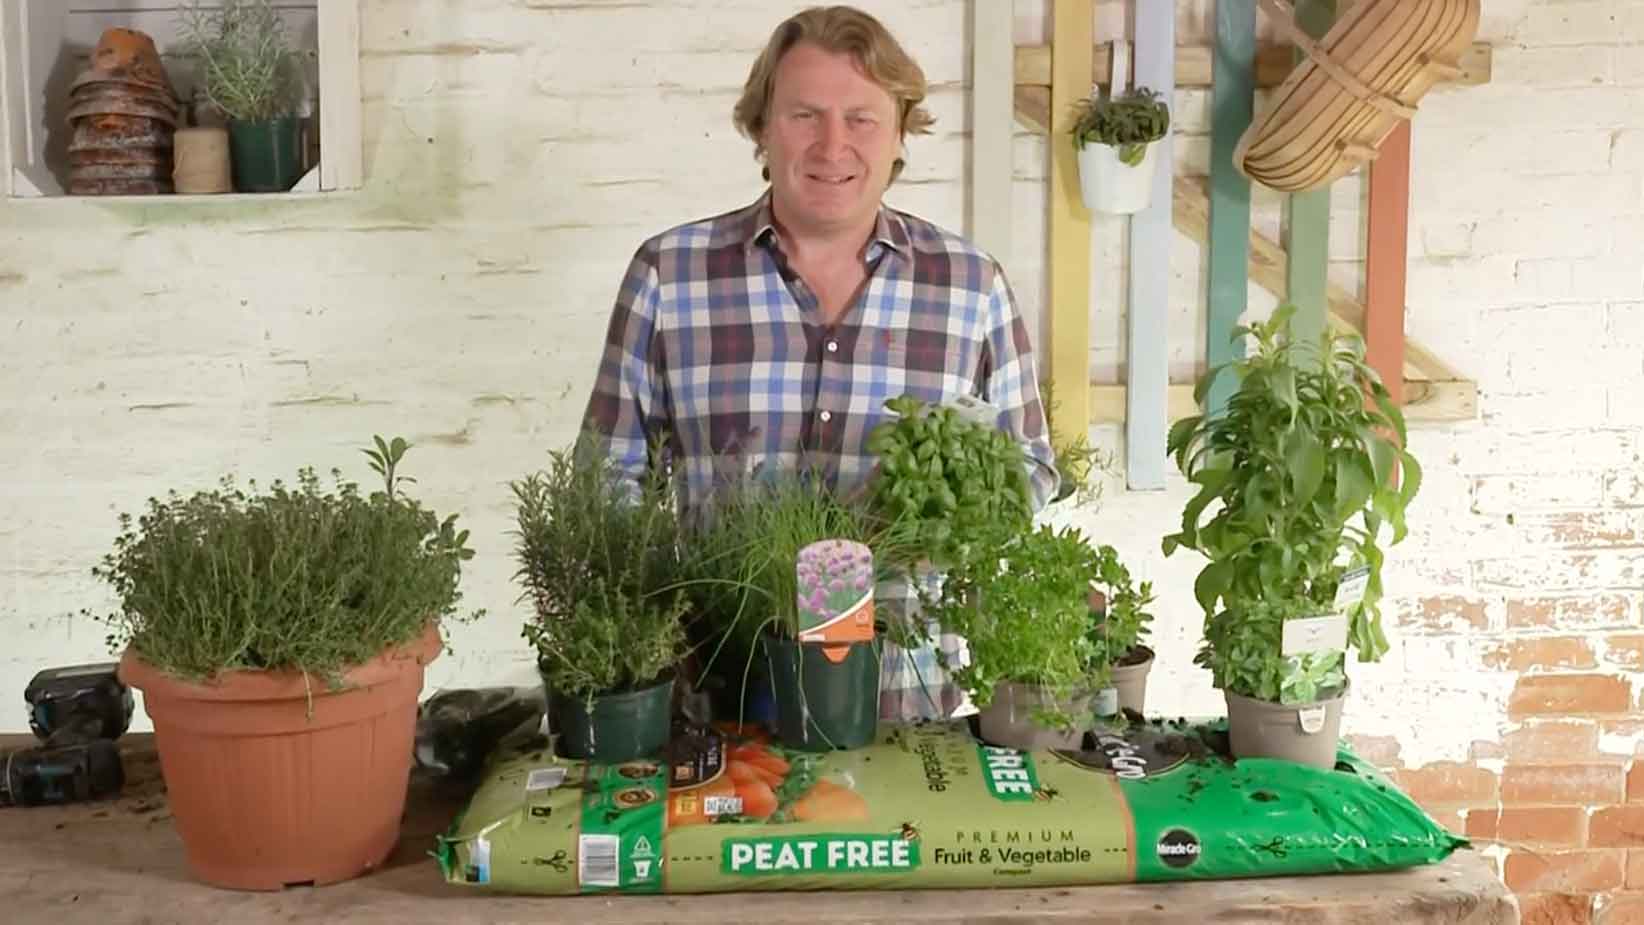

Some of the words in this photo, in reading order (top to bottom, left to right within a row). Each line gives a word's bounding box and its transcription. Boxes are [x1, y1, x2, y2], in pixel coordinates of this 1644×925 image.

[956, 830, 1074, 844] PREMIUM
[731, 842, 818, 871] PEAT
[827, 840, 910, 868] FREE
[934, 848, 973, 864] Fruit
[979, 848, 992, 864] &
[998, 846, 1091, 867] Vegetable
